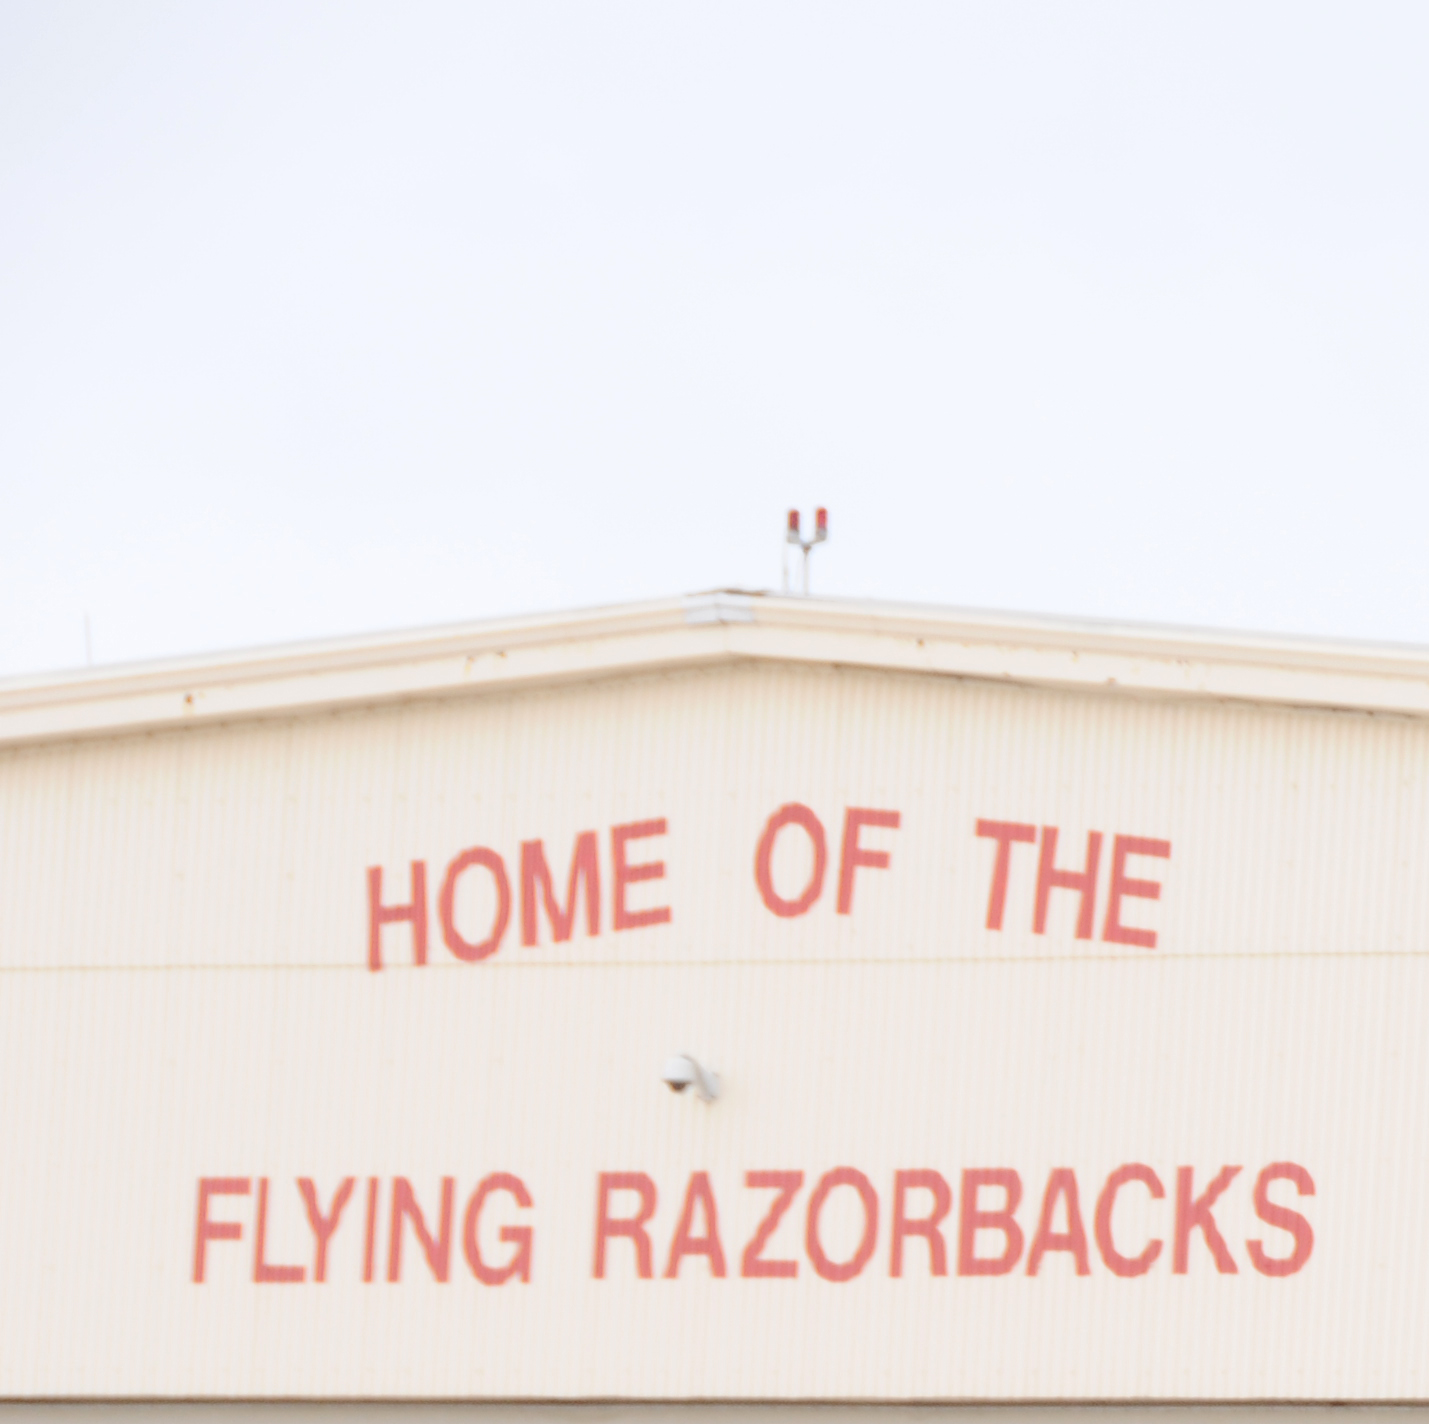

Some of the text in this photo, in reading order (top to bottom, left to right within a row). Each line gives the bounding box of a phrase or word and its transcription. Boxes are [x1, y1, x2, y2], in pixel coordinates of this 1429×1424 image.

[368, 803, 1171, 972] HOME OF THE
[193, 1162, 1316, 1286] FLYING RAZORBACKS
